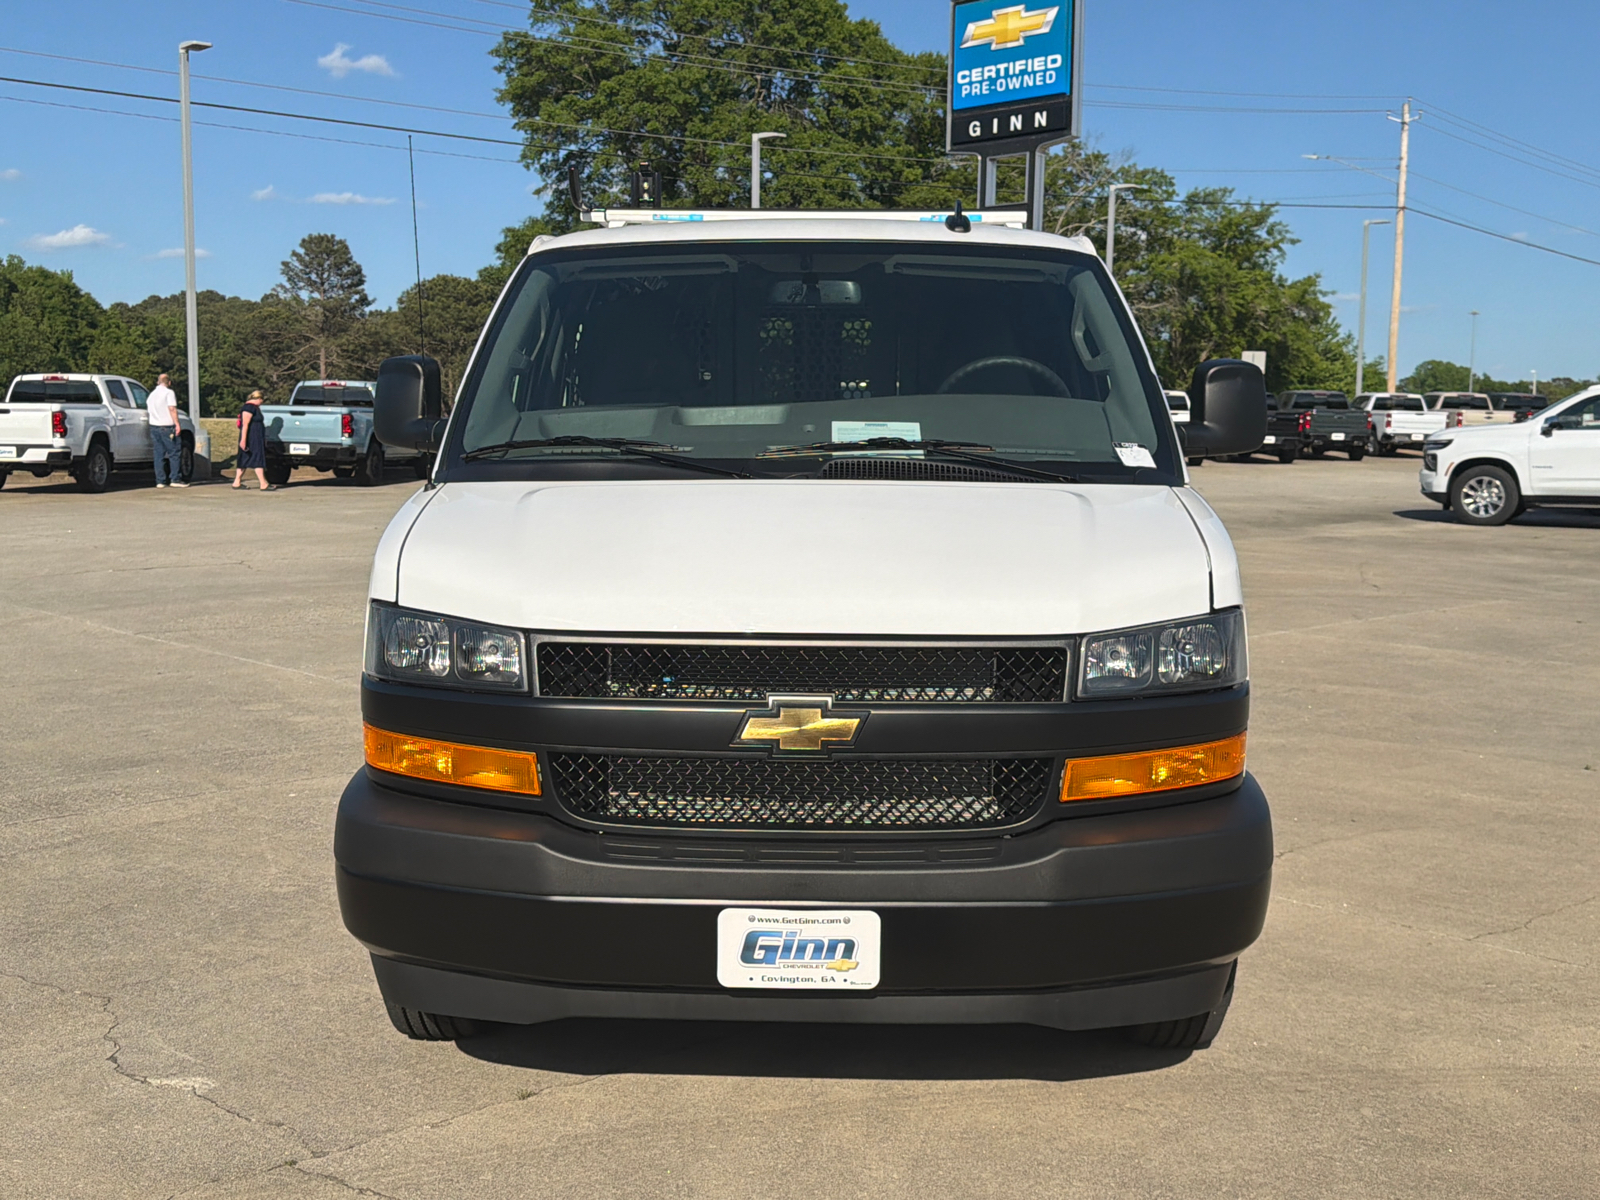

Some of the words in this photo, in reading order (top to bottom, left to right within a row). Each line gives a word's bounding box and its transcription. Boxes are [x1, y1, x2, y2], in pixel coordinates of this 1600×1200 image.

[957, 54, 1062, 84] CERTIFIED
[961, 70, 1056, 98] PRE-OWNED
[968, 111, 1048, 137] GINN
[757, 916, 842, 925] www.GetGinn.com
[740, 930, 856, 965] Ginn
[761, 974, 817, 984] Covington,
[821, 975, 836, 983] GA
